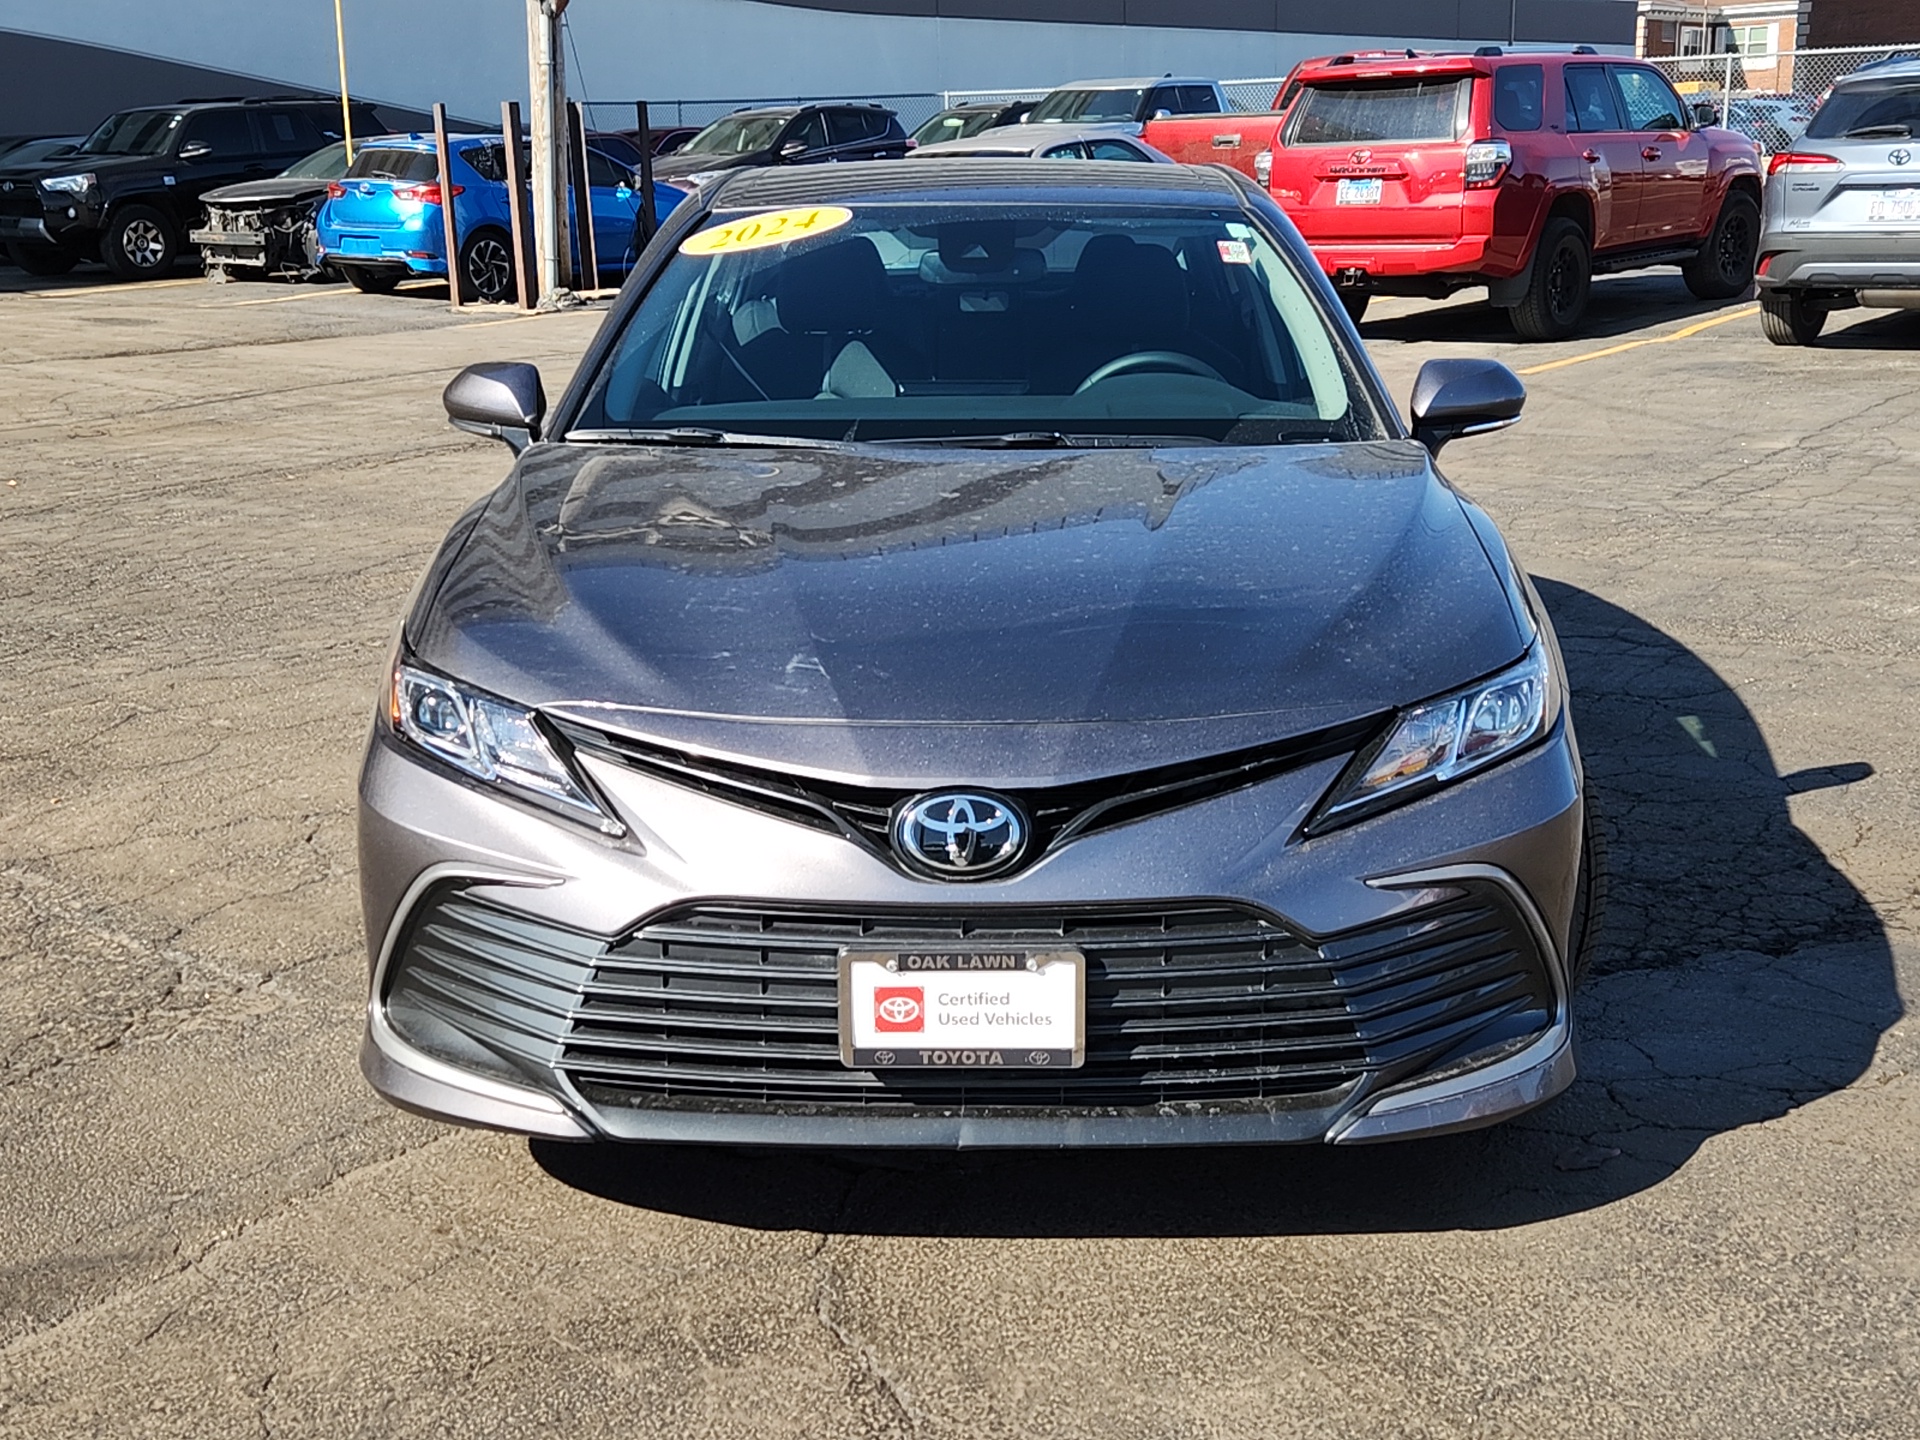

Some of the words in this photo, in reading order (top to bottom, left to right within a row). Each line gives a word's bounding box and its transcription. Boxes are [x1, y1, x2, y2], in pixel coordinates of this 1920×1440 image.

[1891, 199, 1920, 214] 7506
[709, 210, 820, 249] 2024
[907, 954, 951, 970] OAK
[957, 954, 1016, 970] LAWN
[938, 992, 1011, 1006] Certified
[938, 1012, 980, 1026] Used
[984, 1012, 1053, 1026] Vehicles
[919, 1050, 1004, 1066] TOYOTA
